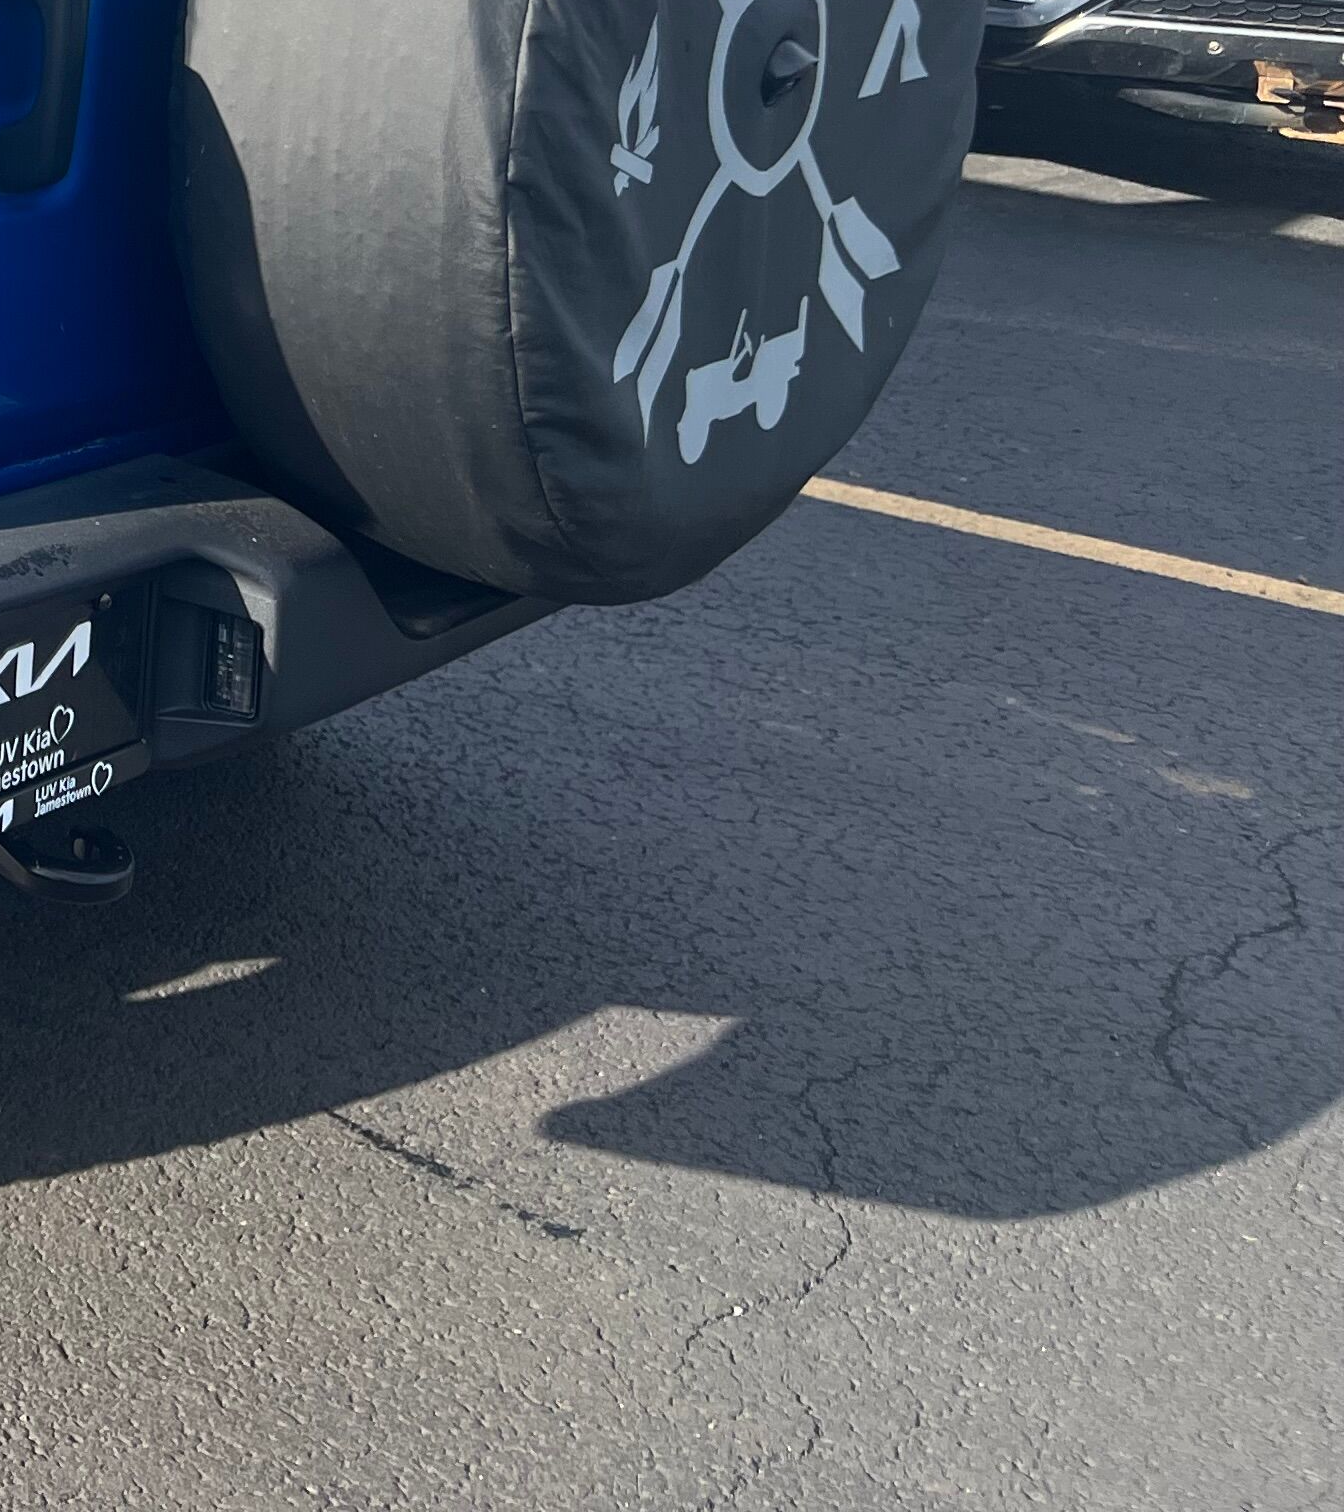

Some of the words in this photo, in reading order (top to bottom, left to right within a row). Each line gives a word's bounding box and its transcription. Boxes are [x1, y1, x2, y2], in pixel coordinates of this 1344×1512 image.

[22, 726, 51, 760] Kia
[33, 782, 92, 818] Jamestown
[34, 780, 58, 804] LUV
[58, 774, 77, 797] Kia
